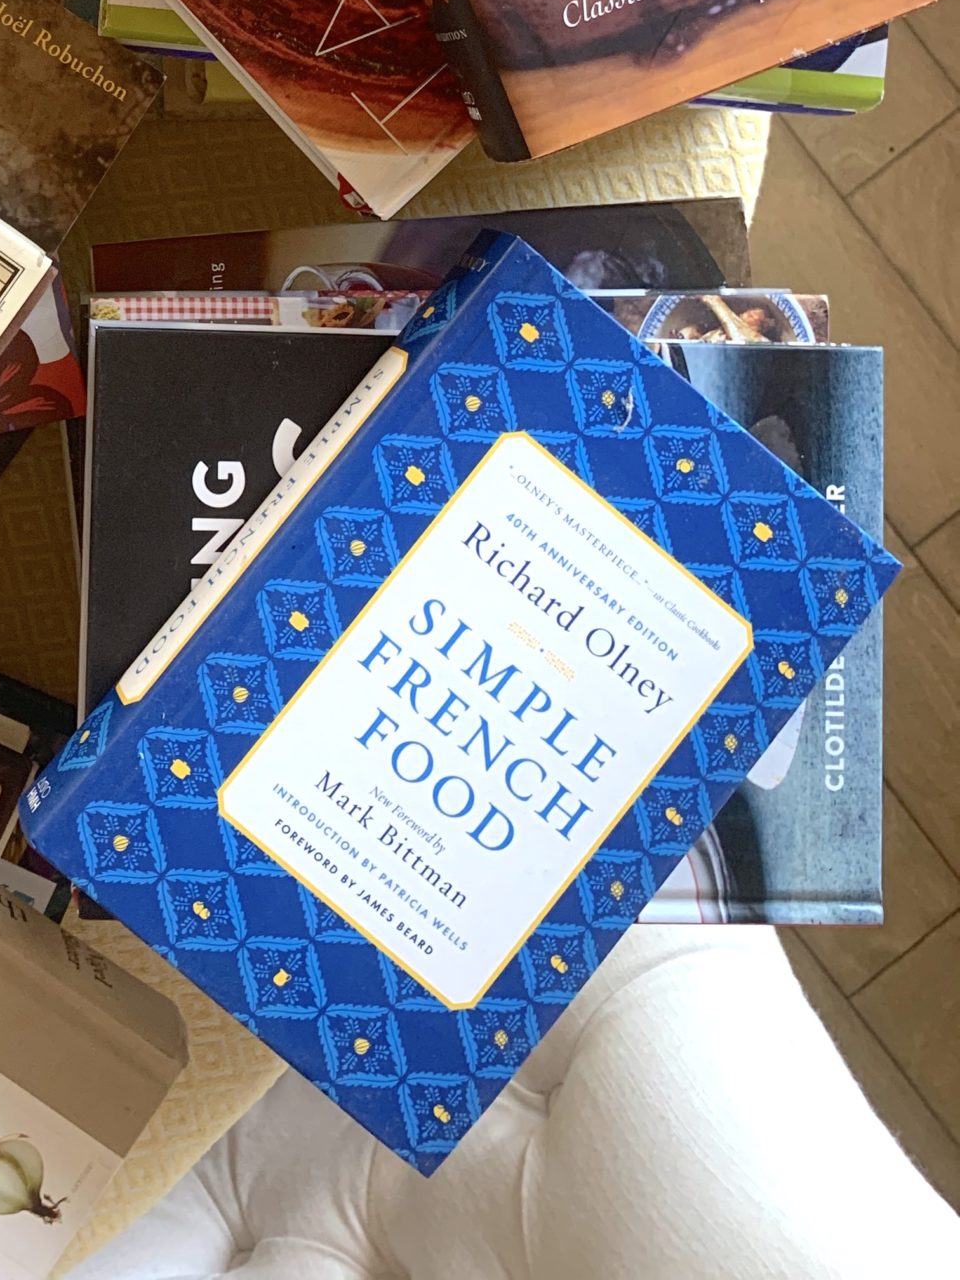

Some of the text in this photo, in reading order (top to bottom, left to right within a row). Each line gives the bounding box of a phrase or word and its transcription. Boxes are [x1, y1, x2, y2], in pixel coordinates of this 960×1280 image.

[33, 28, 130, 104] Robuchon
[460, 520, 675, 715] Richard Olney
[505, 512, 680, 662] 40TH ANNIVERSARY EDITION
[664, 600, 722, 651] Classic Cookbooks
[356, 629, 594, 842] FRENCH
[408, 598, 618, 783] SIMPLE
[314, 769, 469, 909] Mark Bittman
[354, 707, 516, 852] FOOD
[368, 785, 447, 857] New Foreword by
[272, 783, 469, 952] INTRODUCTION BY PATRICIA WELLS
[274, 817, 434, 956] FOREWORD BY JAMES BEARD
